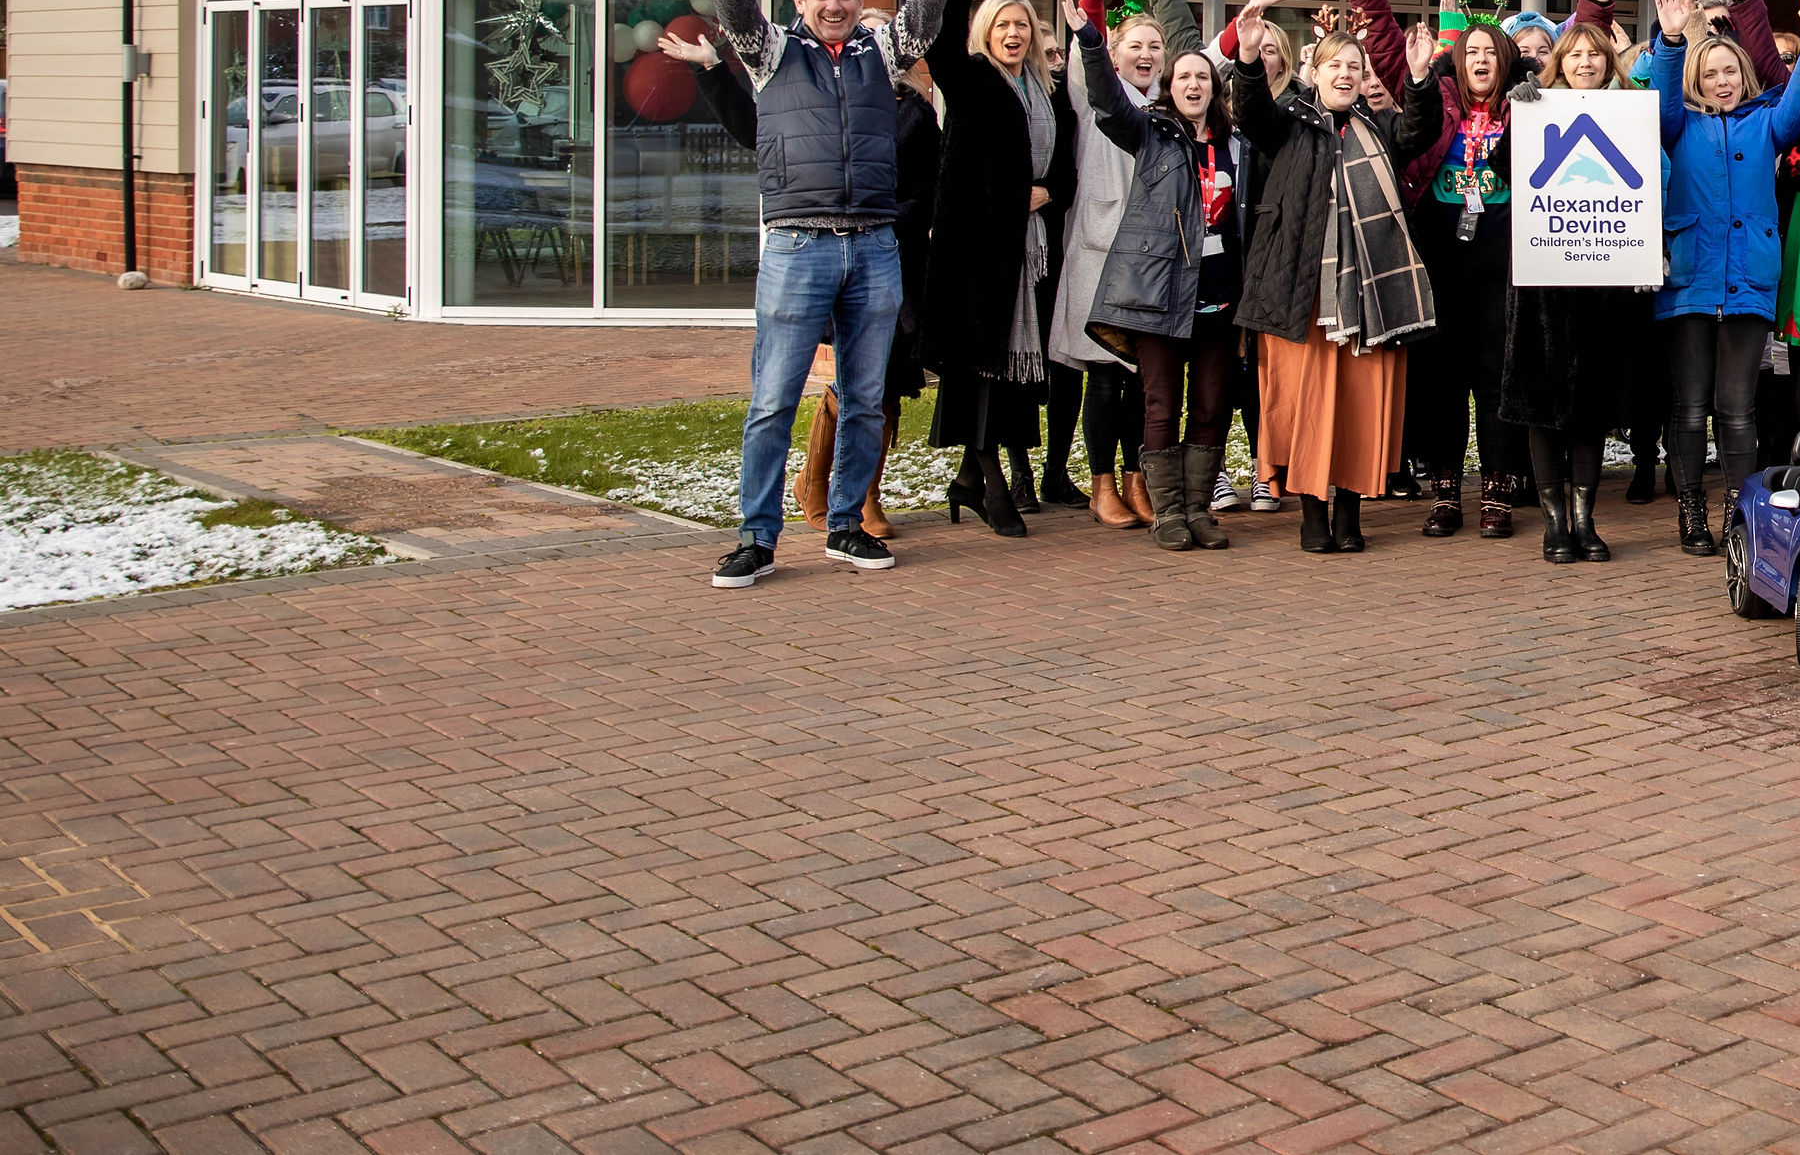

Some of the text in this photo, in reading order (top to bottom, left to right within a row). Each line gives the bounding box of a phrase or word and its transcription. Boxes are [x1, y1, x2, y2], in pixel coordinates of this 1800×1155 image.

[1530, 195, 1643, 213] Alexander
[1549, 215, 1626, 234] Devine
[1530, 236, 1645, 249] Children's Hospice
[1564, 251, 1611, 262] Service
